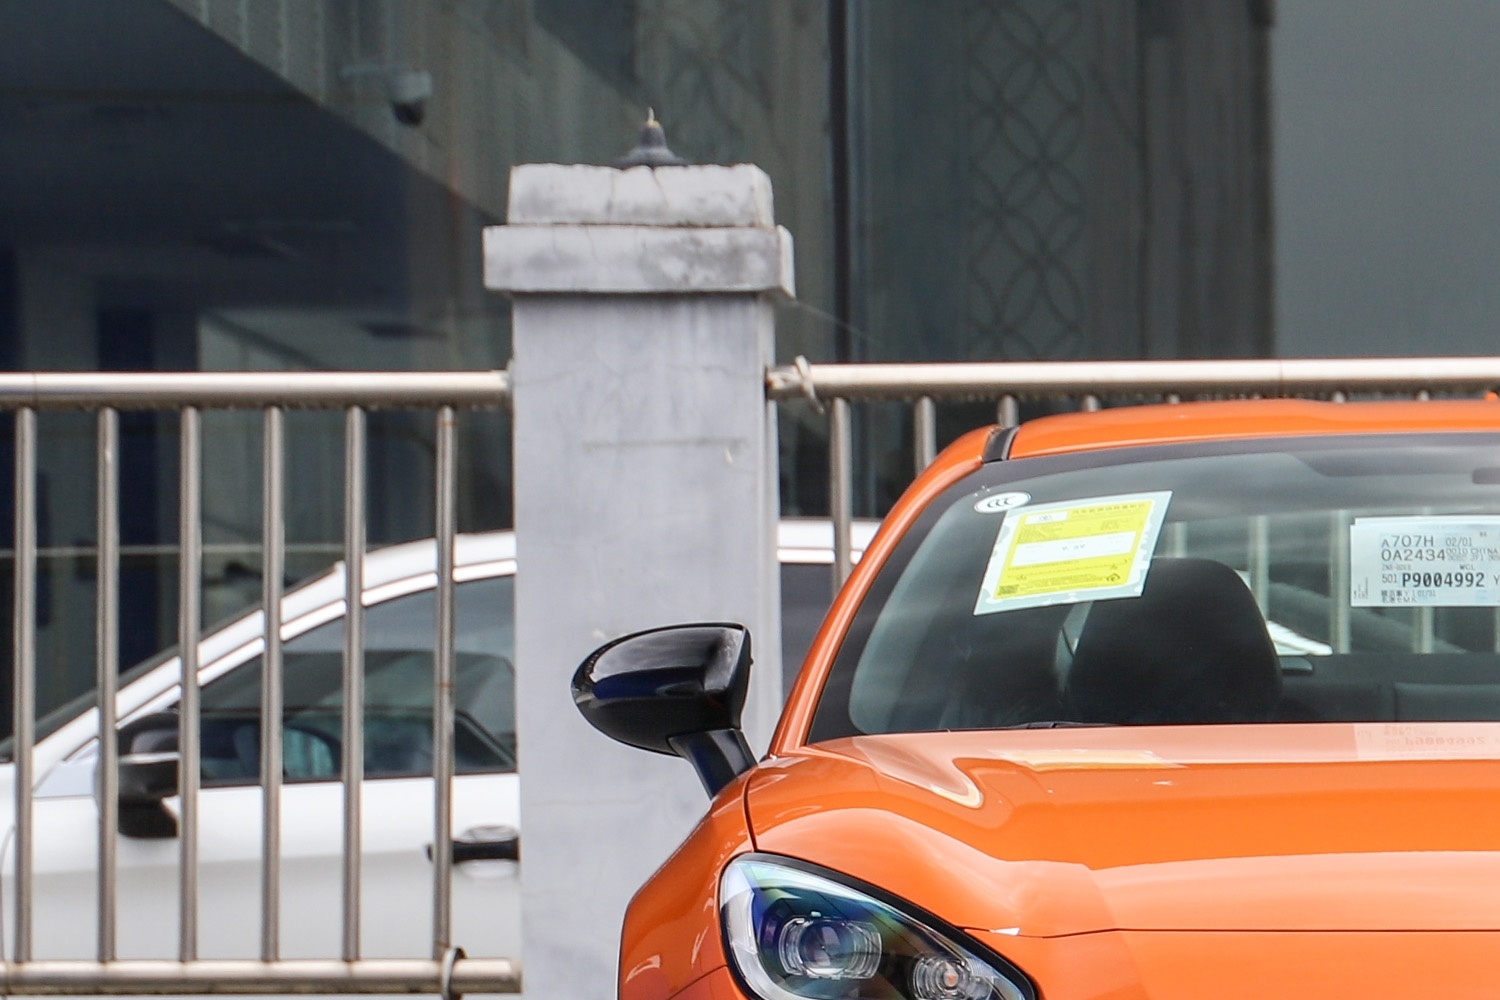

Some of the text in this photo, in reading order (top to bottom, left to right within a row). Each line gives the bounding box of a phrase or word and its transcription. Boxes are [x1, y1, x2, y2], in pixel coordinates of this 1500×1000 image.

[1381, 535, 1472, 548] A707H 02/01
[1381, 574, 1398, 584] 501
[1402, 572, 1485, 588] P9004992
